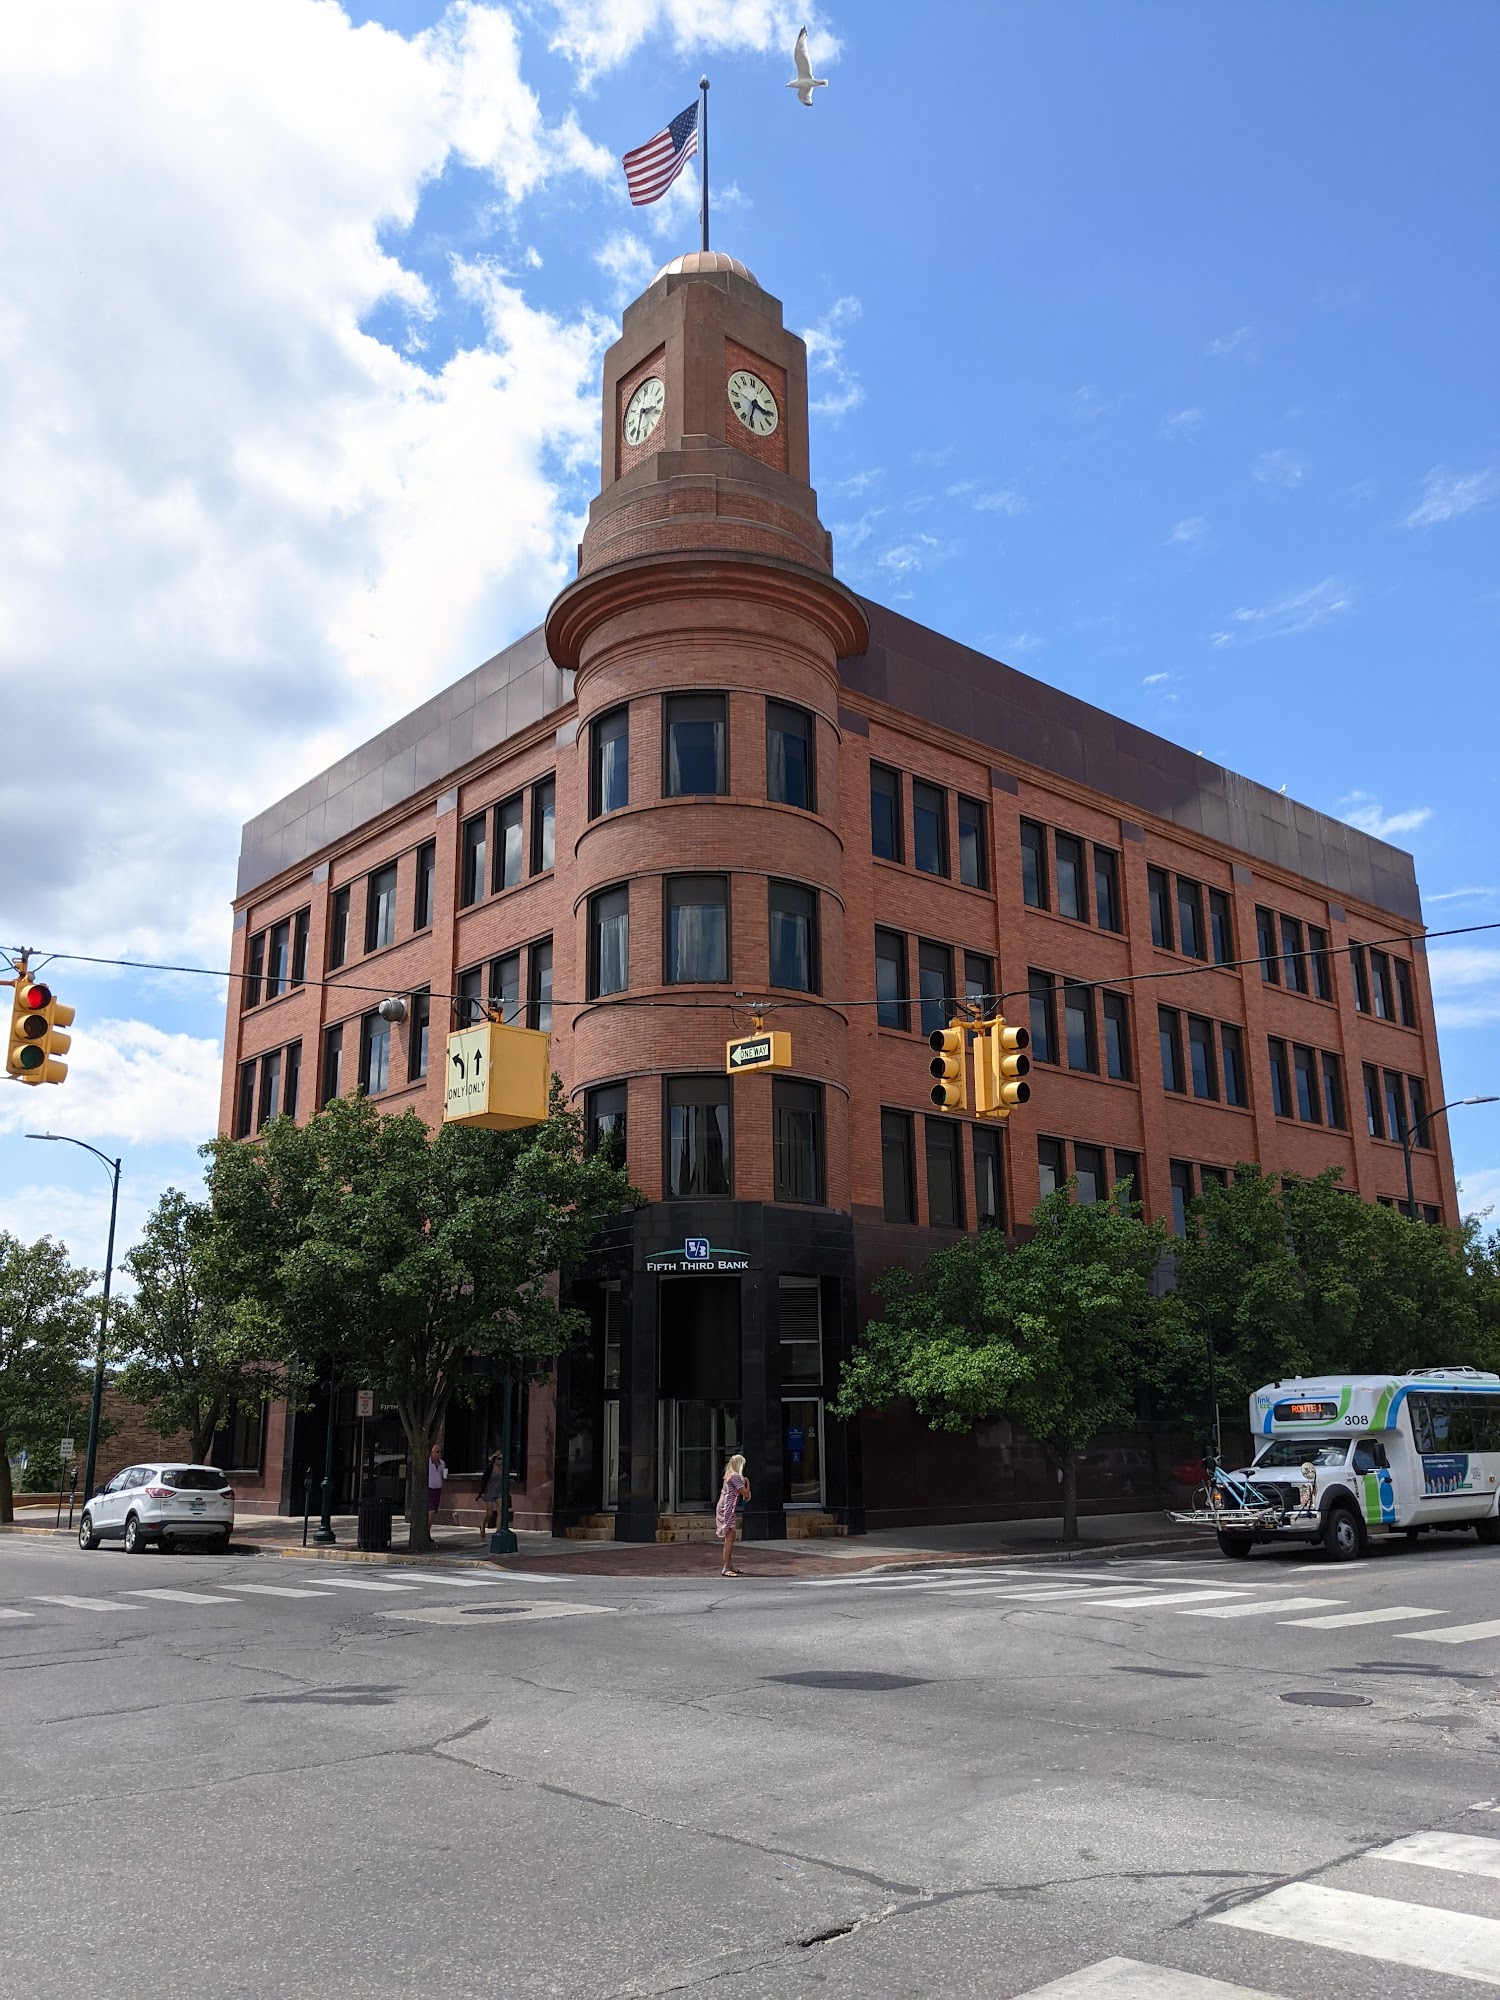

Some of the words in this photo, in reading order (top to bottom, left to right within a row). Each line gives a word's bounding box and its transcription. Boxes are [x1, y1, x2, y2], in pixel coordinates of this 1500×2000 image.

[740, 1048, 753, 1059] ONE
[753, 1045, 767, 1056] WAY
[448, 1085, 466, 1100] ONLY
[468, 1080, 486, 1095] ONLY
[646, 1262, 677, 1272] FIFTH
[680, 1261, 715, 1271] THIRD
[717, 1260, 749, 1270] BANK
[1257, 1395, 1271, 1404] link
[1291, 1404, 1317, 1414] ROUTE
[1318, 1404, 1323, 1412] 1
[1344, 1415, 1369, 1426] 308
